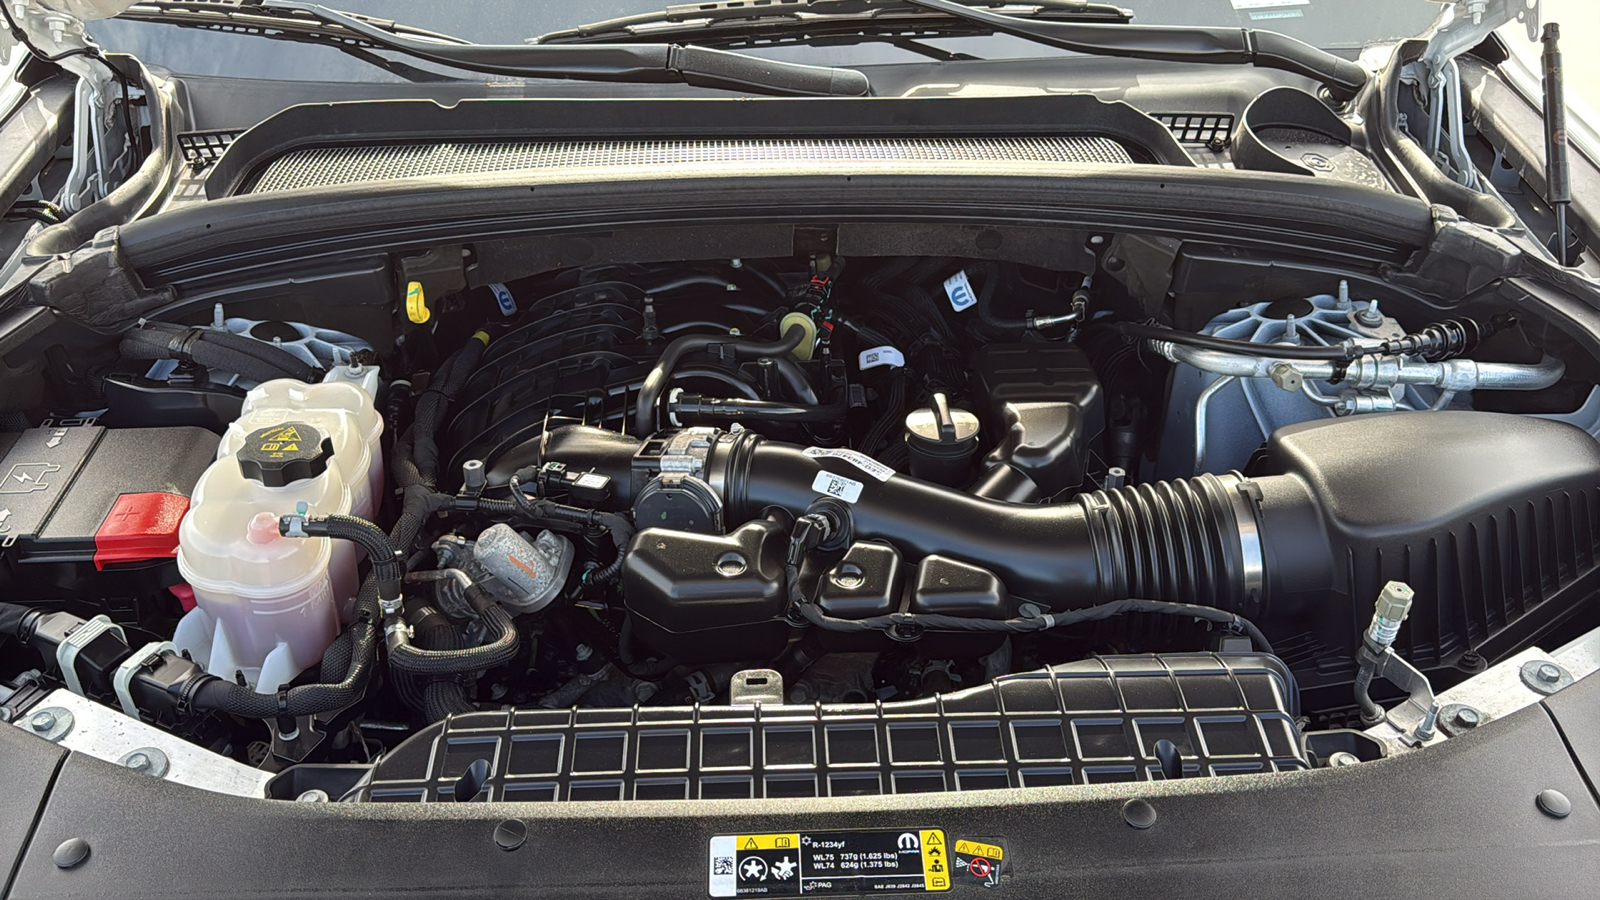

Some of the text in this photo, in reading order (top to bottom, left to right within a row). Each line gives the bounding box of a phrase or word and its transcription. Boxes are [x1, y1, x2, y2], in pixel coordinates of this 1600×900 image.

[812, 841, 845, 849] R-1234yf
[812, 852, 898, 861] WL75 737g (1.625 lbs)
[813, 861, 899, 870] WL74 624g (1.375 lbs)
